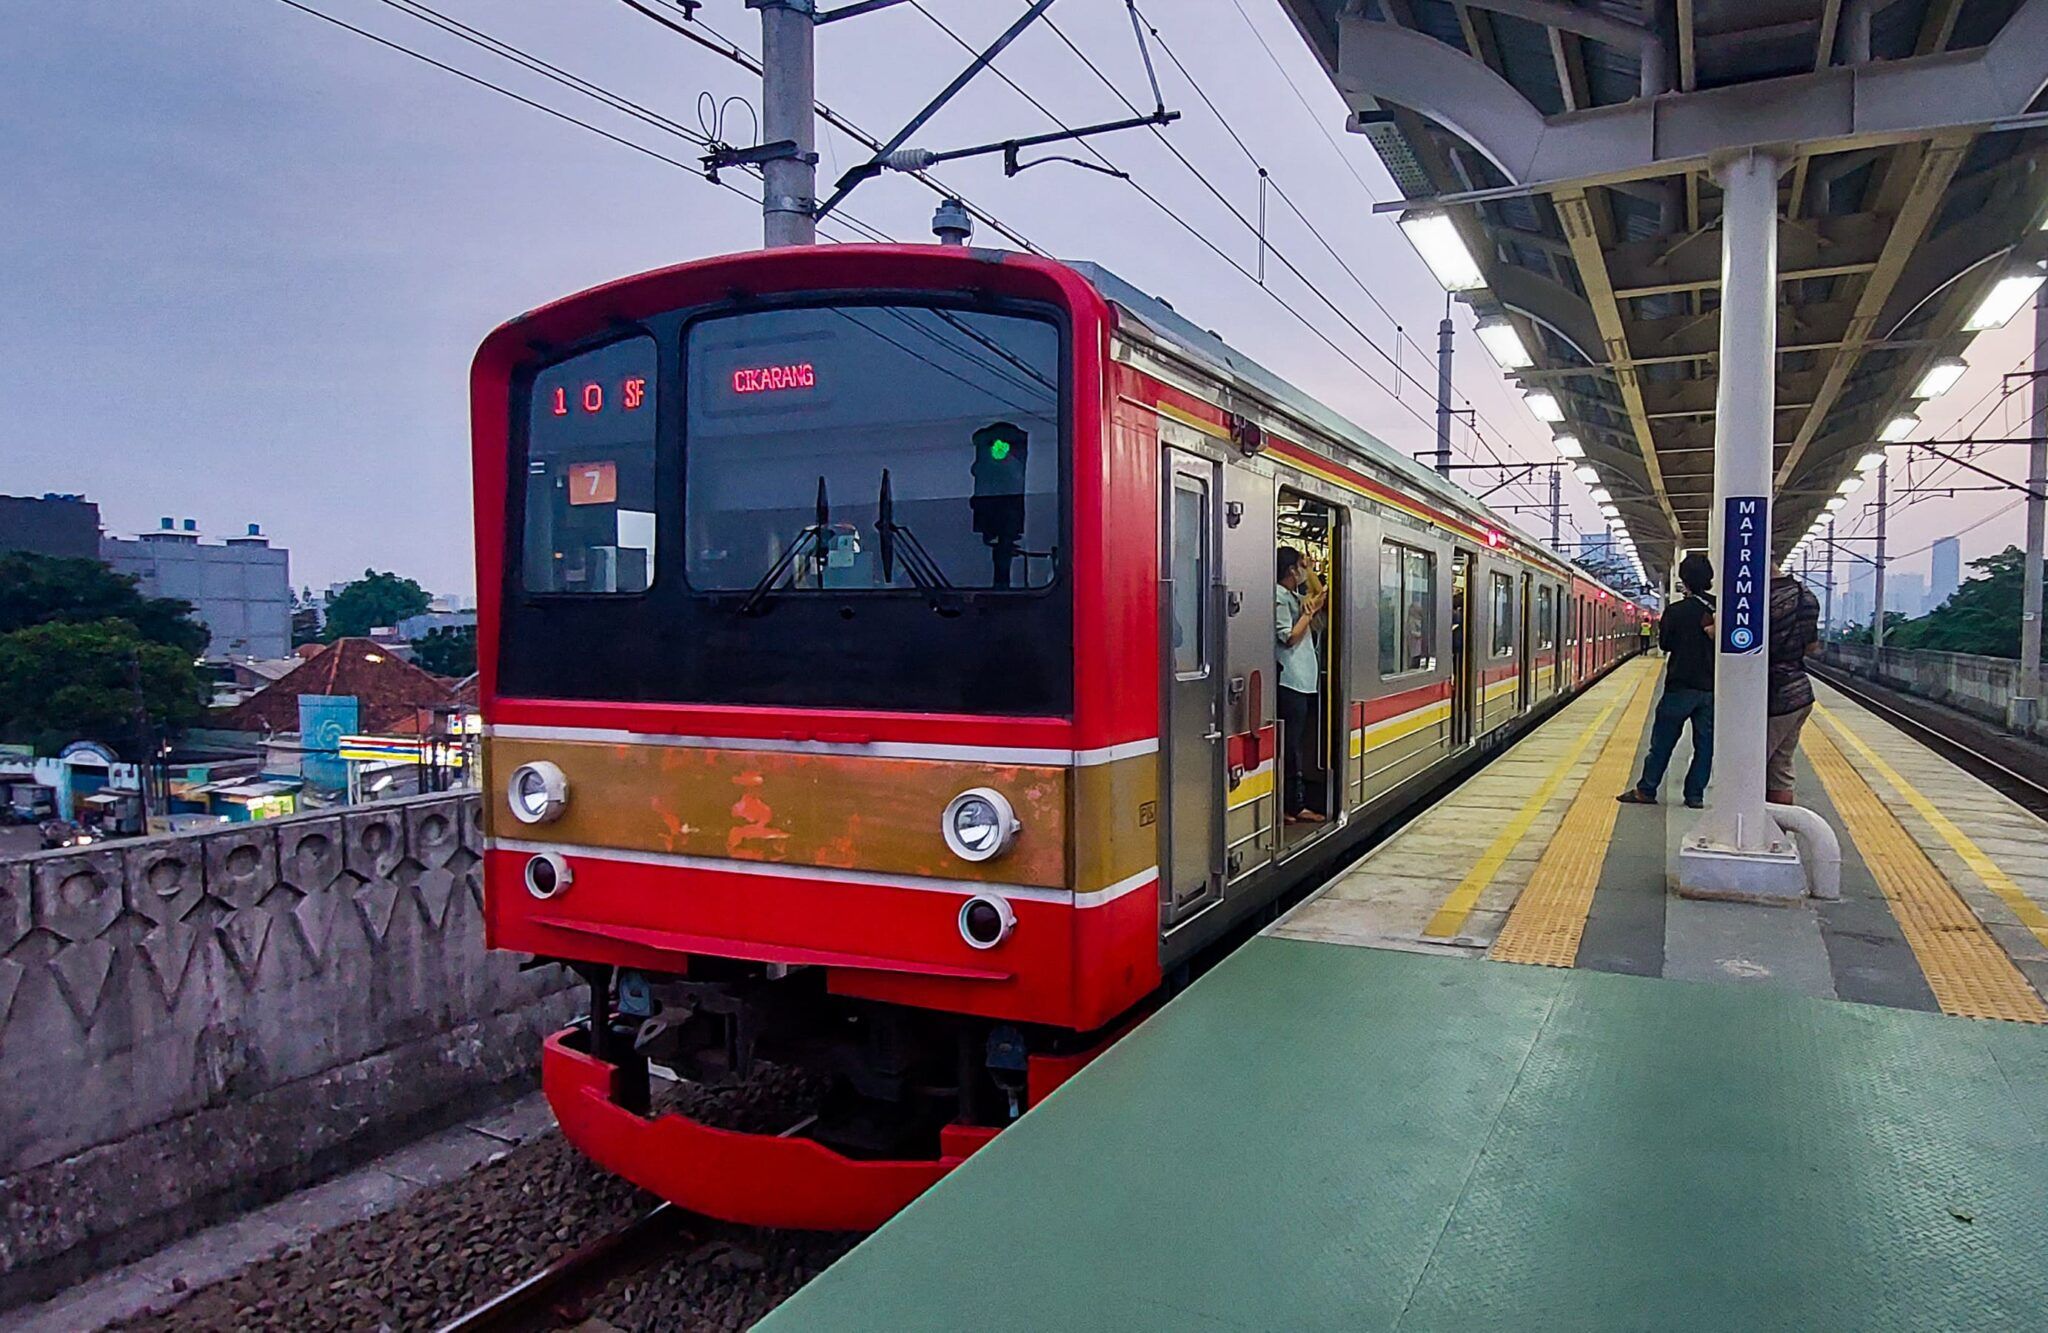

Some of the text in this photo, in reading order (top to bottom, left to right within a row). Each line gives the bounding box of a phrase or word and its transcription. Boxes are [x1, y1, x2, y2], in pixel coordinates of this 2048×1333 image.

[624, 378, 646, 408] SF
[734, 363, 815, 393] CIKARANG
[584, 470, 600, 496] 7
[1735, 501, 1755, 626] MATRAMAN
